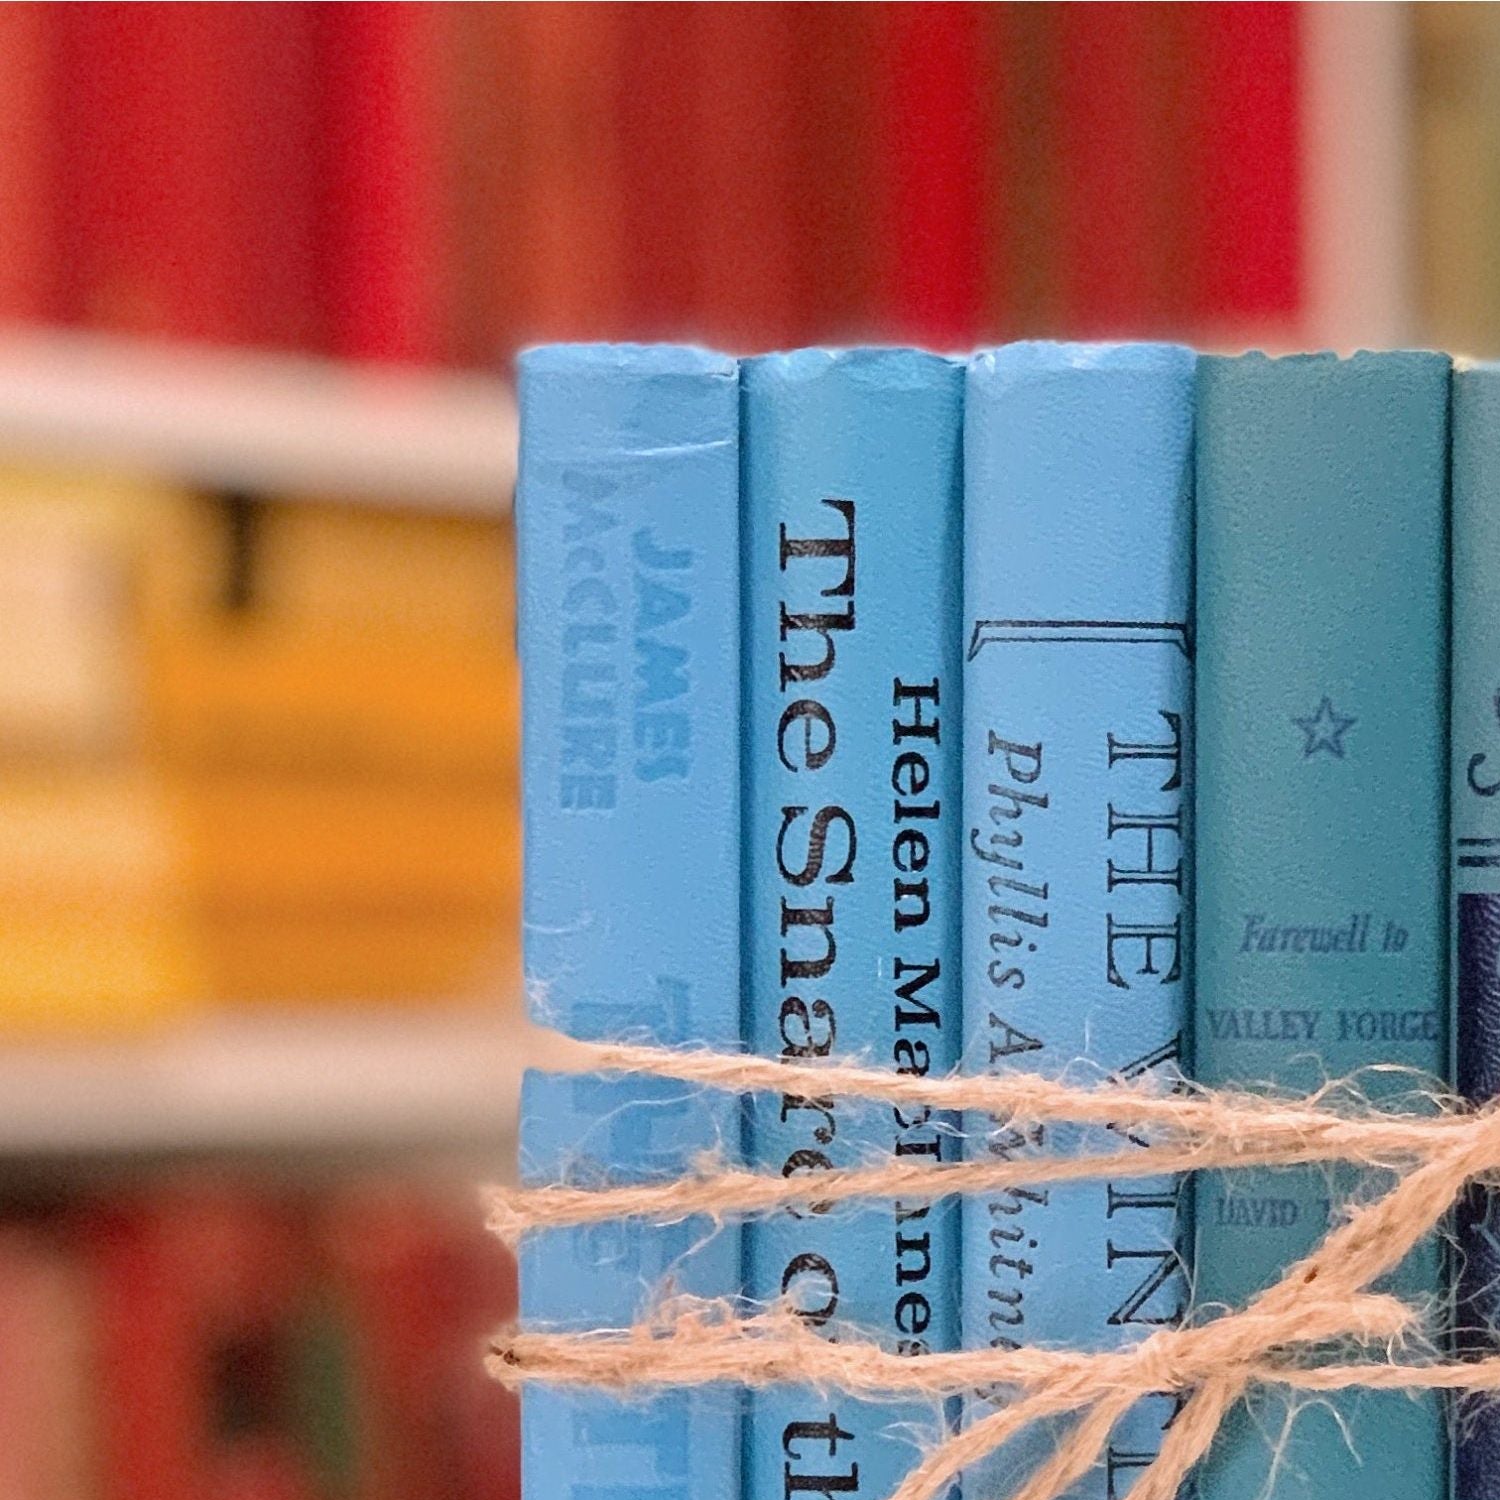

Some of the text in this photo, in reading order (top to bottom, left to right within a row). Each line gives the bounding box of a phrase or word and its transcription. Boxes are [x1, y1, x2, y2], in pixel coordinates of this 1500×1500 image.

[632, 526, 695, 784] JAMES
[776, 499, 856, 773] The
[891, 676, 941, 933] Helen
[970, 729, 1049, 990] Phyllis
[1106, 708, 1184, 990] THE
[1240, 913, 1409, 953] Farewell to
[1206, 1008, 1440, 1042] VALLEY FORGE
[1216, 1199, 1299, 1227] DAVID
